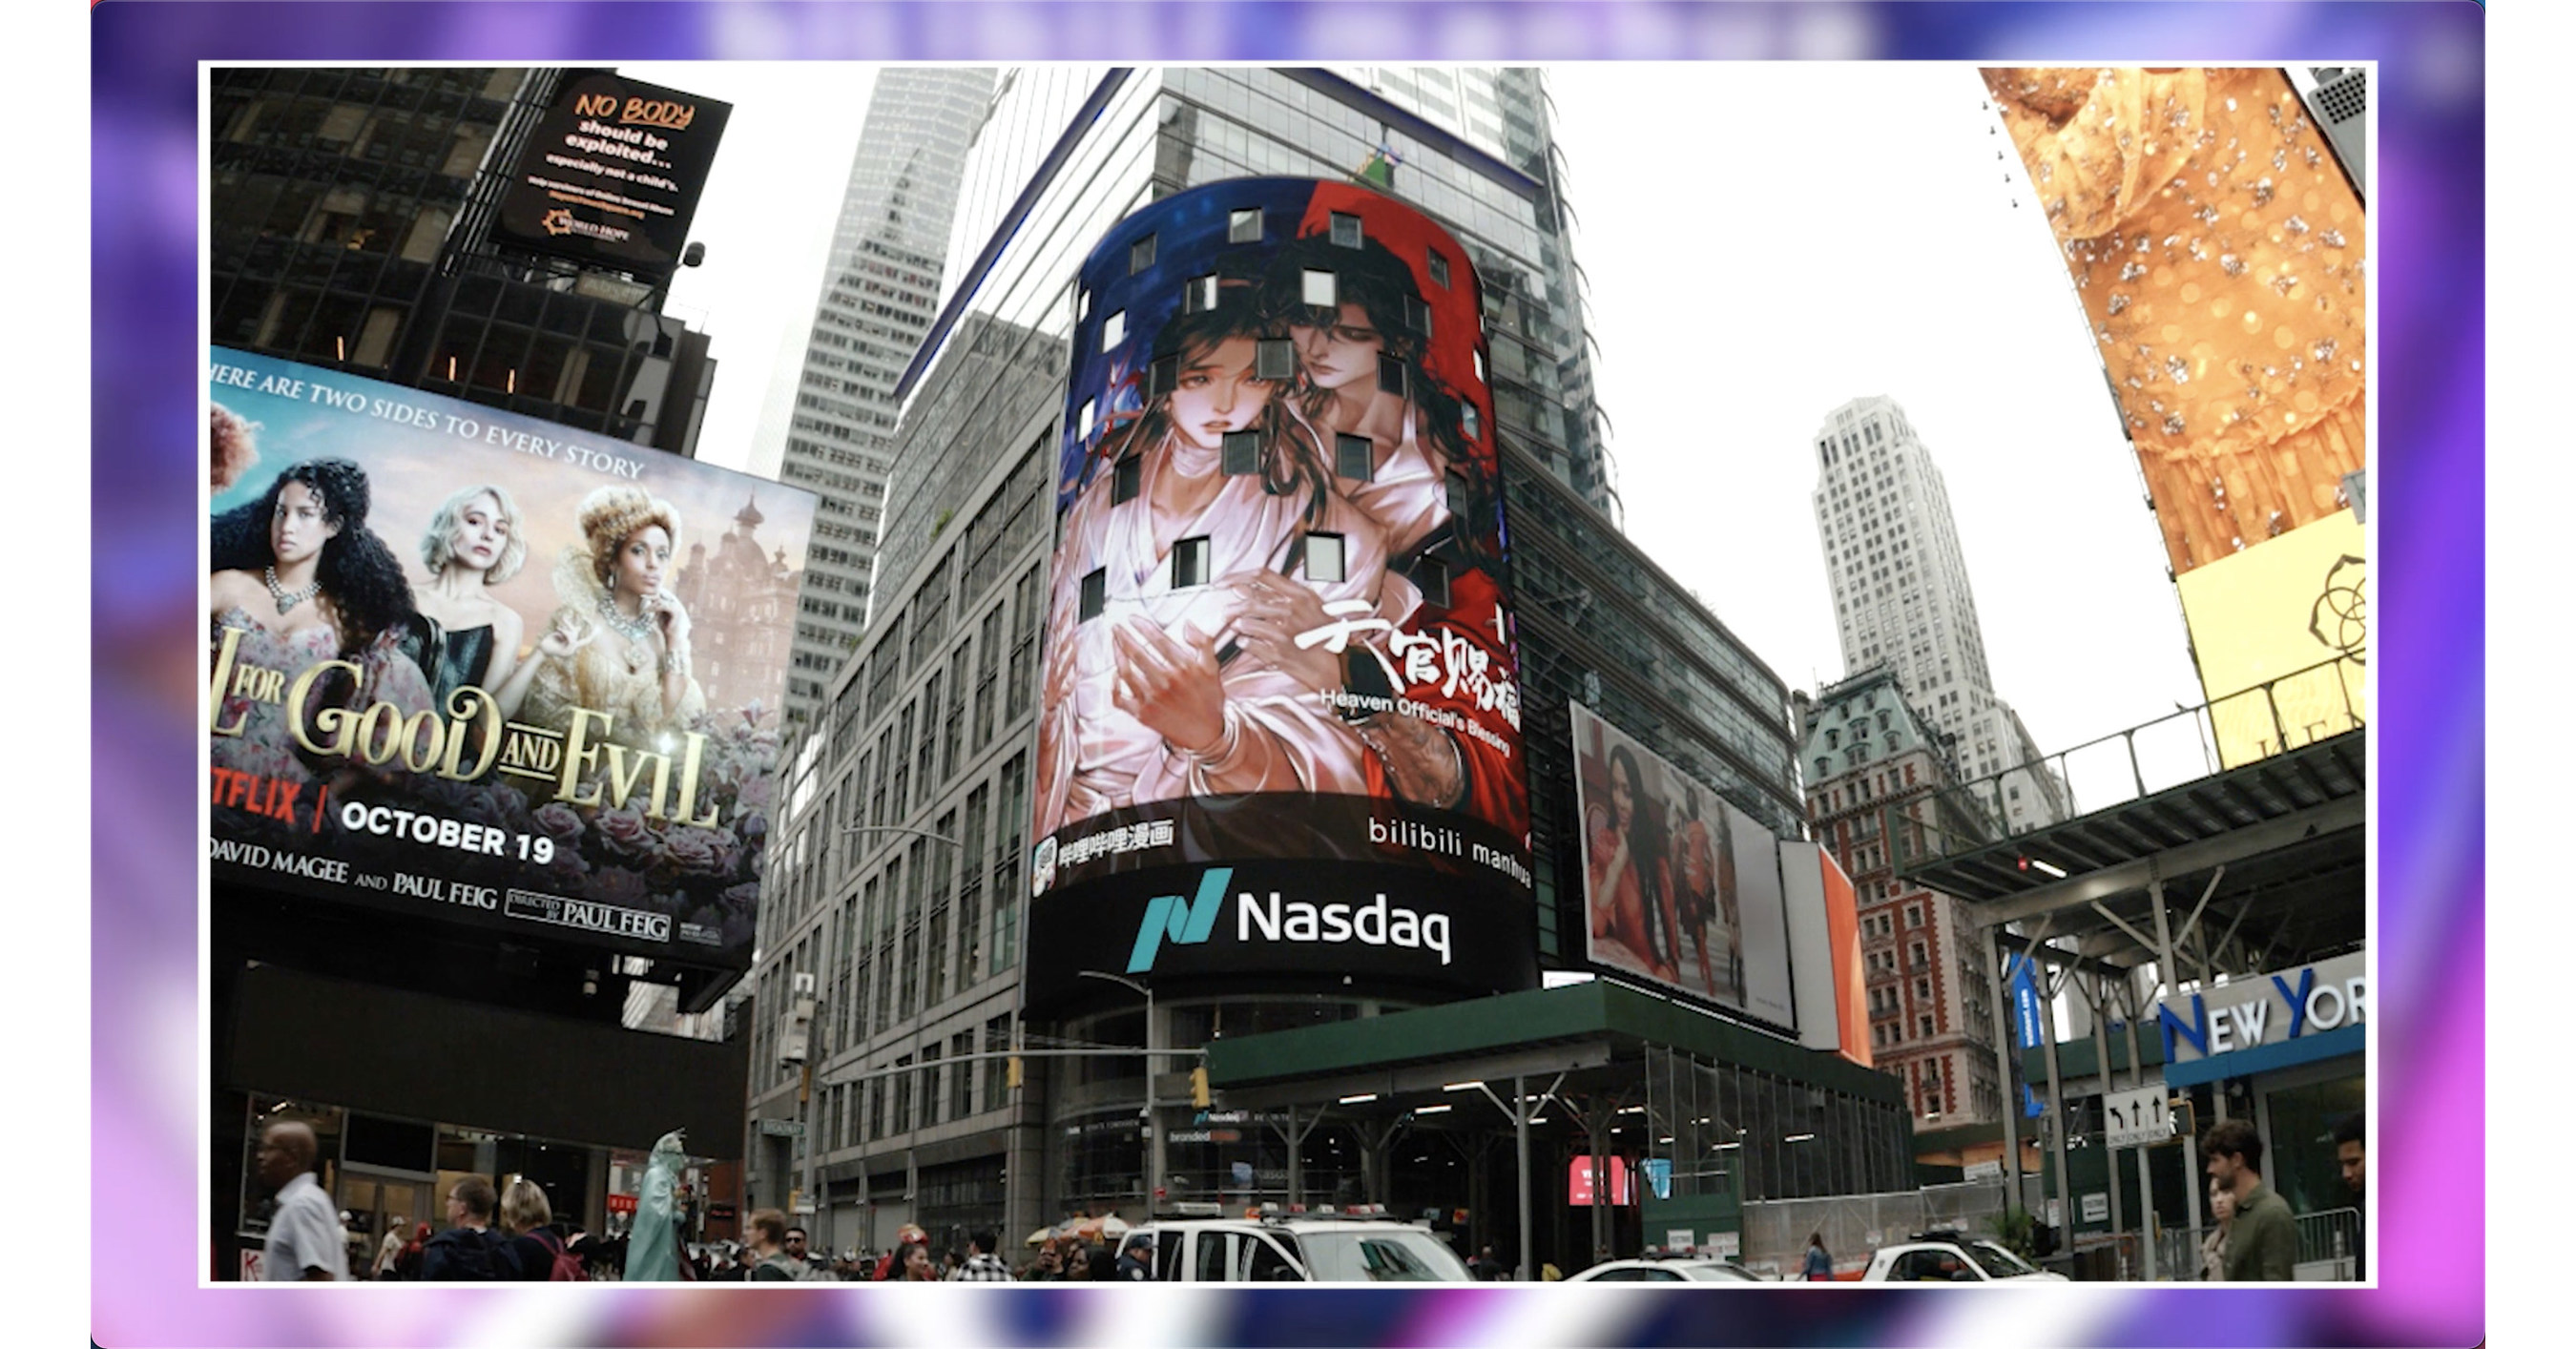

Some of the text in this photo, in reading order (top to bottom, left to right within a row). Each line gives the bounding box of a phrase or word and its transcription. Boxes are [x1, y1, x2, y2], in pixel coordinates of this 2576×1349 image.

[574, 94, 696, 128] NO BODY
[579, 119, 669, 151] should be
[546, 153, 605, 176] especially
[605, 163, 628, 181] not
[628, 171, 635, 181] a
[557, 216, 599, 234] WORLD
[600, 222, 630, 240] HOPE
[257, 374, 303, 400] ARE
[309, 384, 367, 414] TWO
[370, 399, 440, 430] SIDES
[446, 414, 479, 440] TO
[486, 425, 562, 459] EVERY
[564, 444, 646, 480] STORY
[232, 663, 285, 705] FOR
[500, 731, 561, 773] AND
[1320, 687, 1510, 758] Heaven Official's Blessing
[211, 766, 555, 865] TFLIX OCTOBER 19
[1058, 817, 1174, 869] 哔哩哔哩漫画
[1367, 816, 1531, 889] bilibili manhua
[271, 851, 350, 883] MAGEE
[354, 872, 387, 891] AND
[392, 872, 446, 902] PAUL
[448, 881, 498, 910] FEIG
[509, 892, 561, 911] DIRECTED
[547, 908, 560, 921] BY
[562, 902, 616, 929] PAUL
[618, 911, 668, 939] FEIG
[1237, 891, 1453, 965] Nasdaq
[2159, 966, 2365, 1064] NEW YOR
